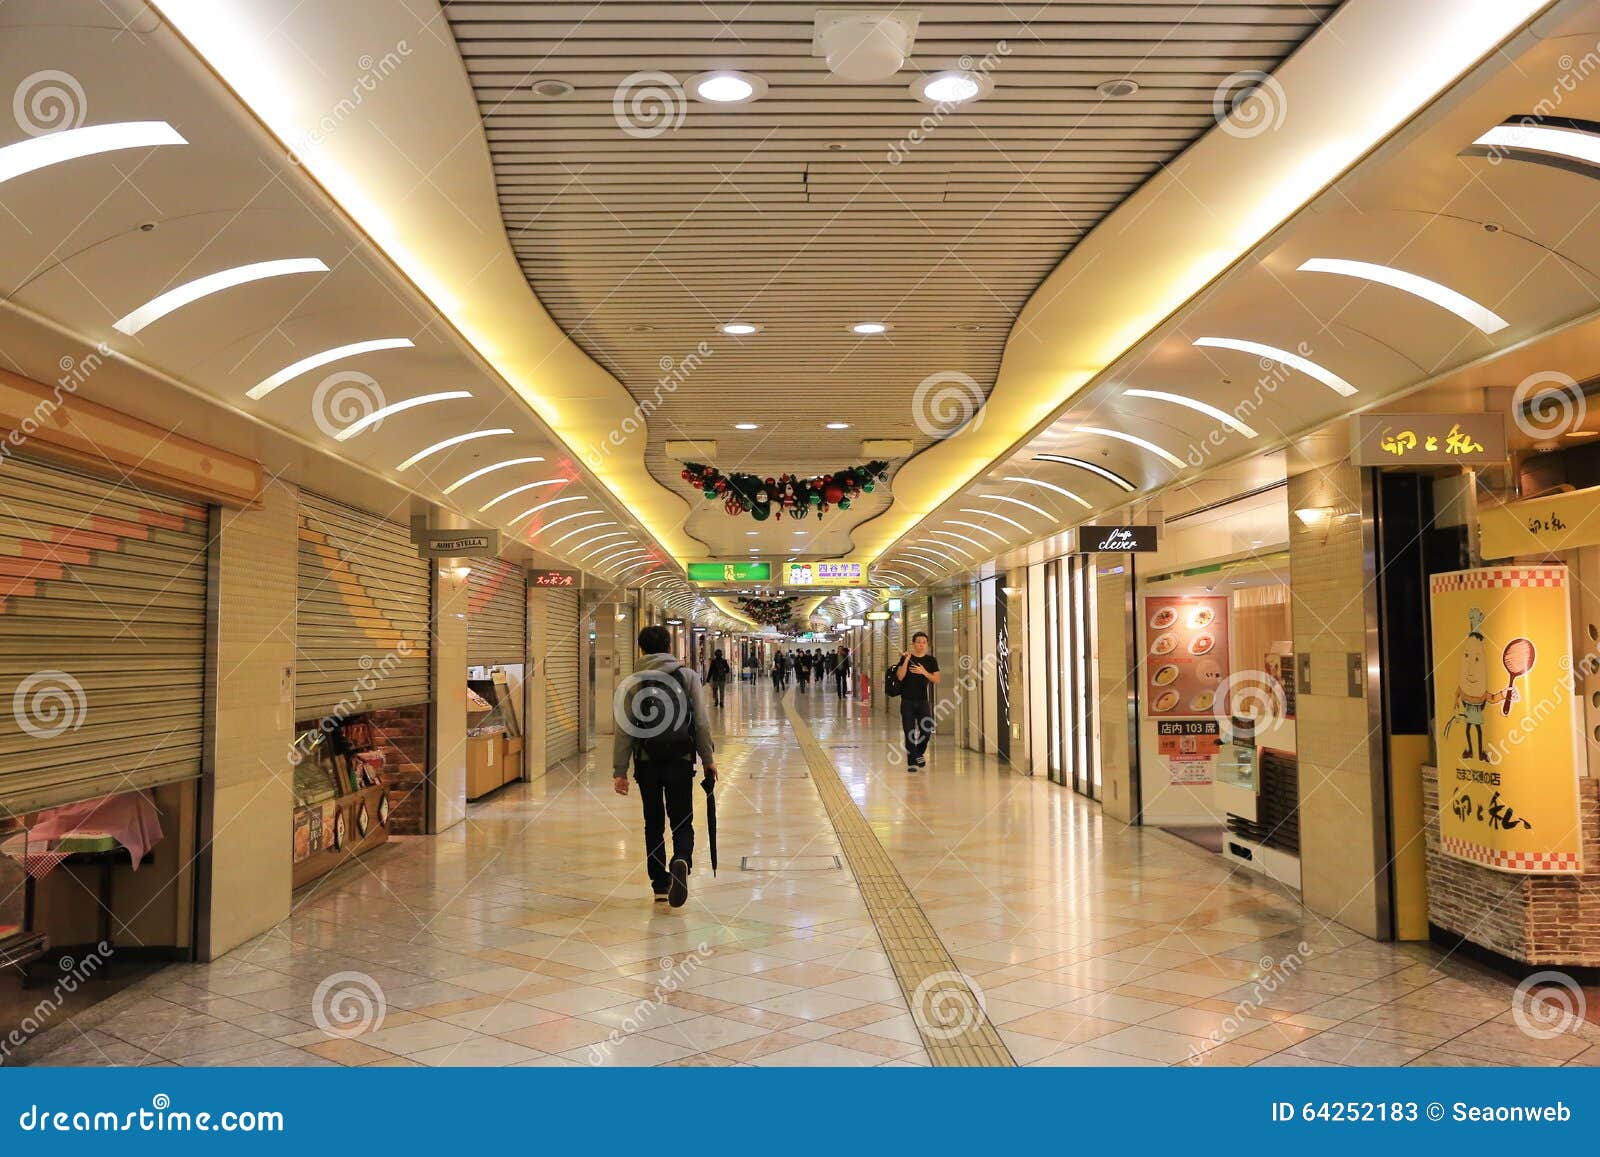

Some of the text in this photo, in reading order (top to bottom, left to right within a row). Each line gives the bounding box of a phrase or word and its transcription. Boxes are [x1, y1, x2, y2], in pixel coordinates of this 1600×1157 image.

[1381, 423, 1484, 456] 卵と私
[1098, 528, 1138, 550] clever
[1161, 722, 1217, 734] 店内 103 席
[1452, 787, 1532, 830] 卵と私
